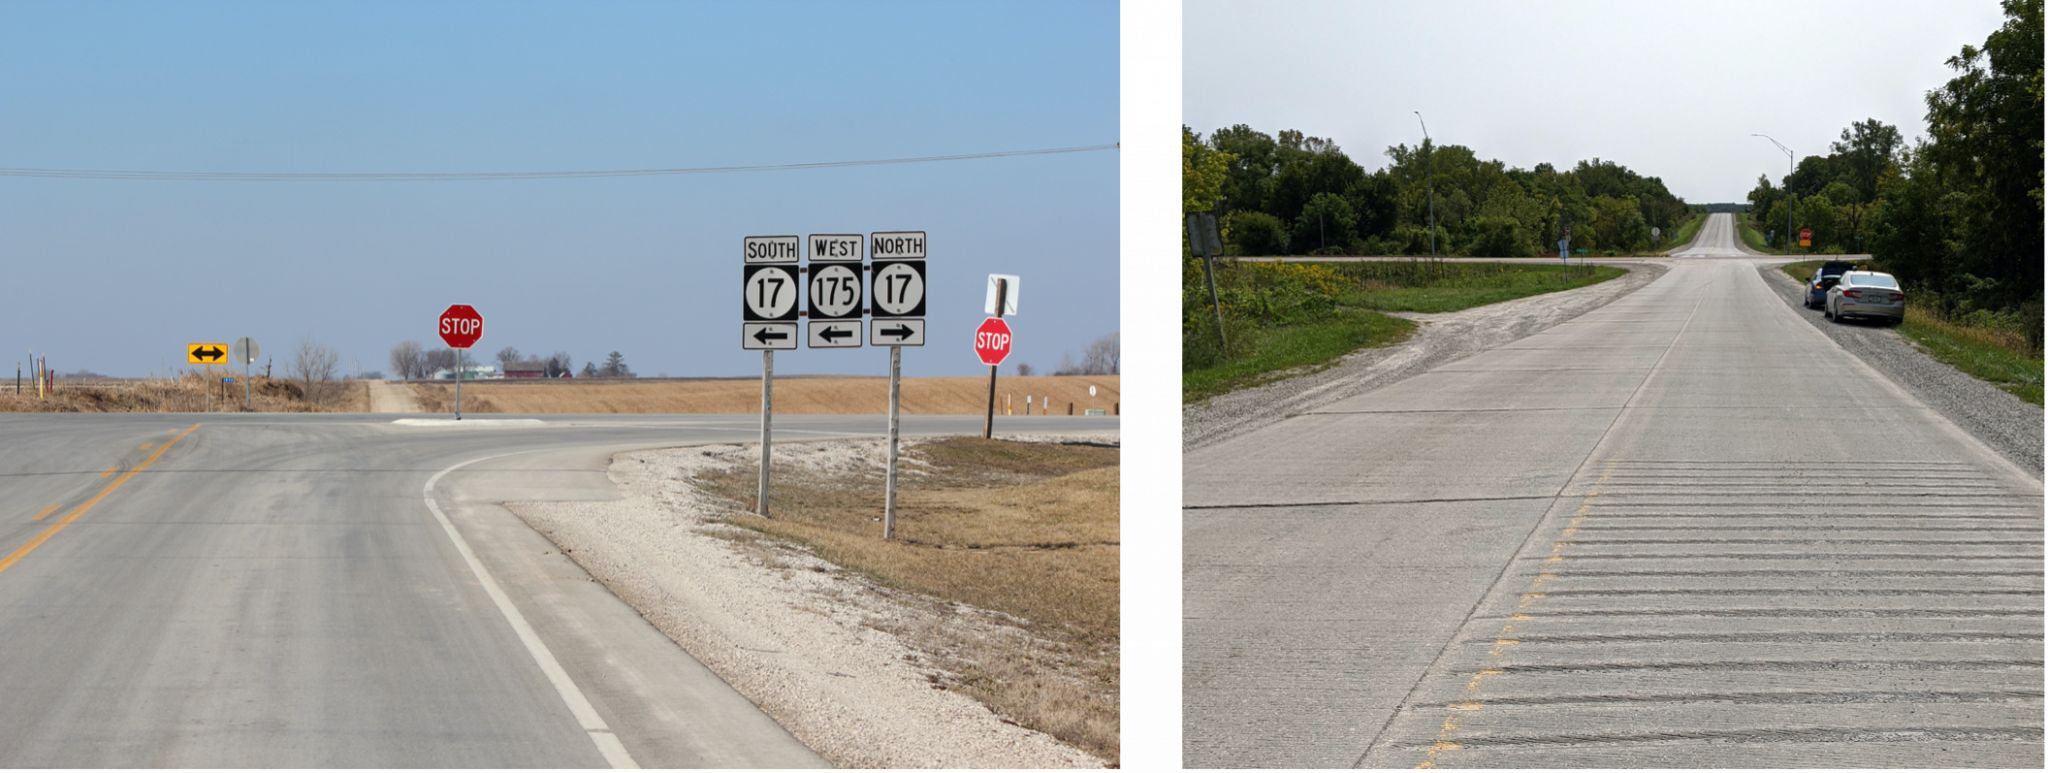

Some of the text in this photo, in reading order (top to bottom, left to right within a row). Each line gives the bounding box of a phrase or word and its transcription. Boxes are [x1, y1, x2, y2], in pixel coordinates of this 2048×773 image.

[747, 241, 796, 259] SOUTH
[815, 239, 857, 257] WEST
[874, 237, 923, 254] NORTH
[757, 278, 785, 308] 17
[816, 276, 854, 306] 175
[885, 274, 912, 304] 17
[441, 317, 480, 335] STOP
[977, 331, 1009, 351] STOP
